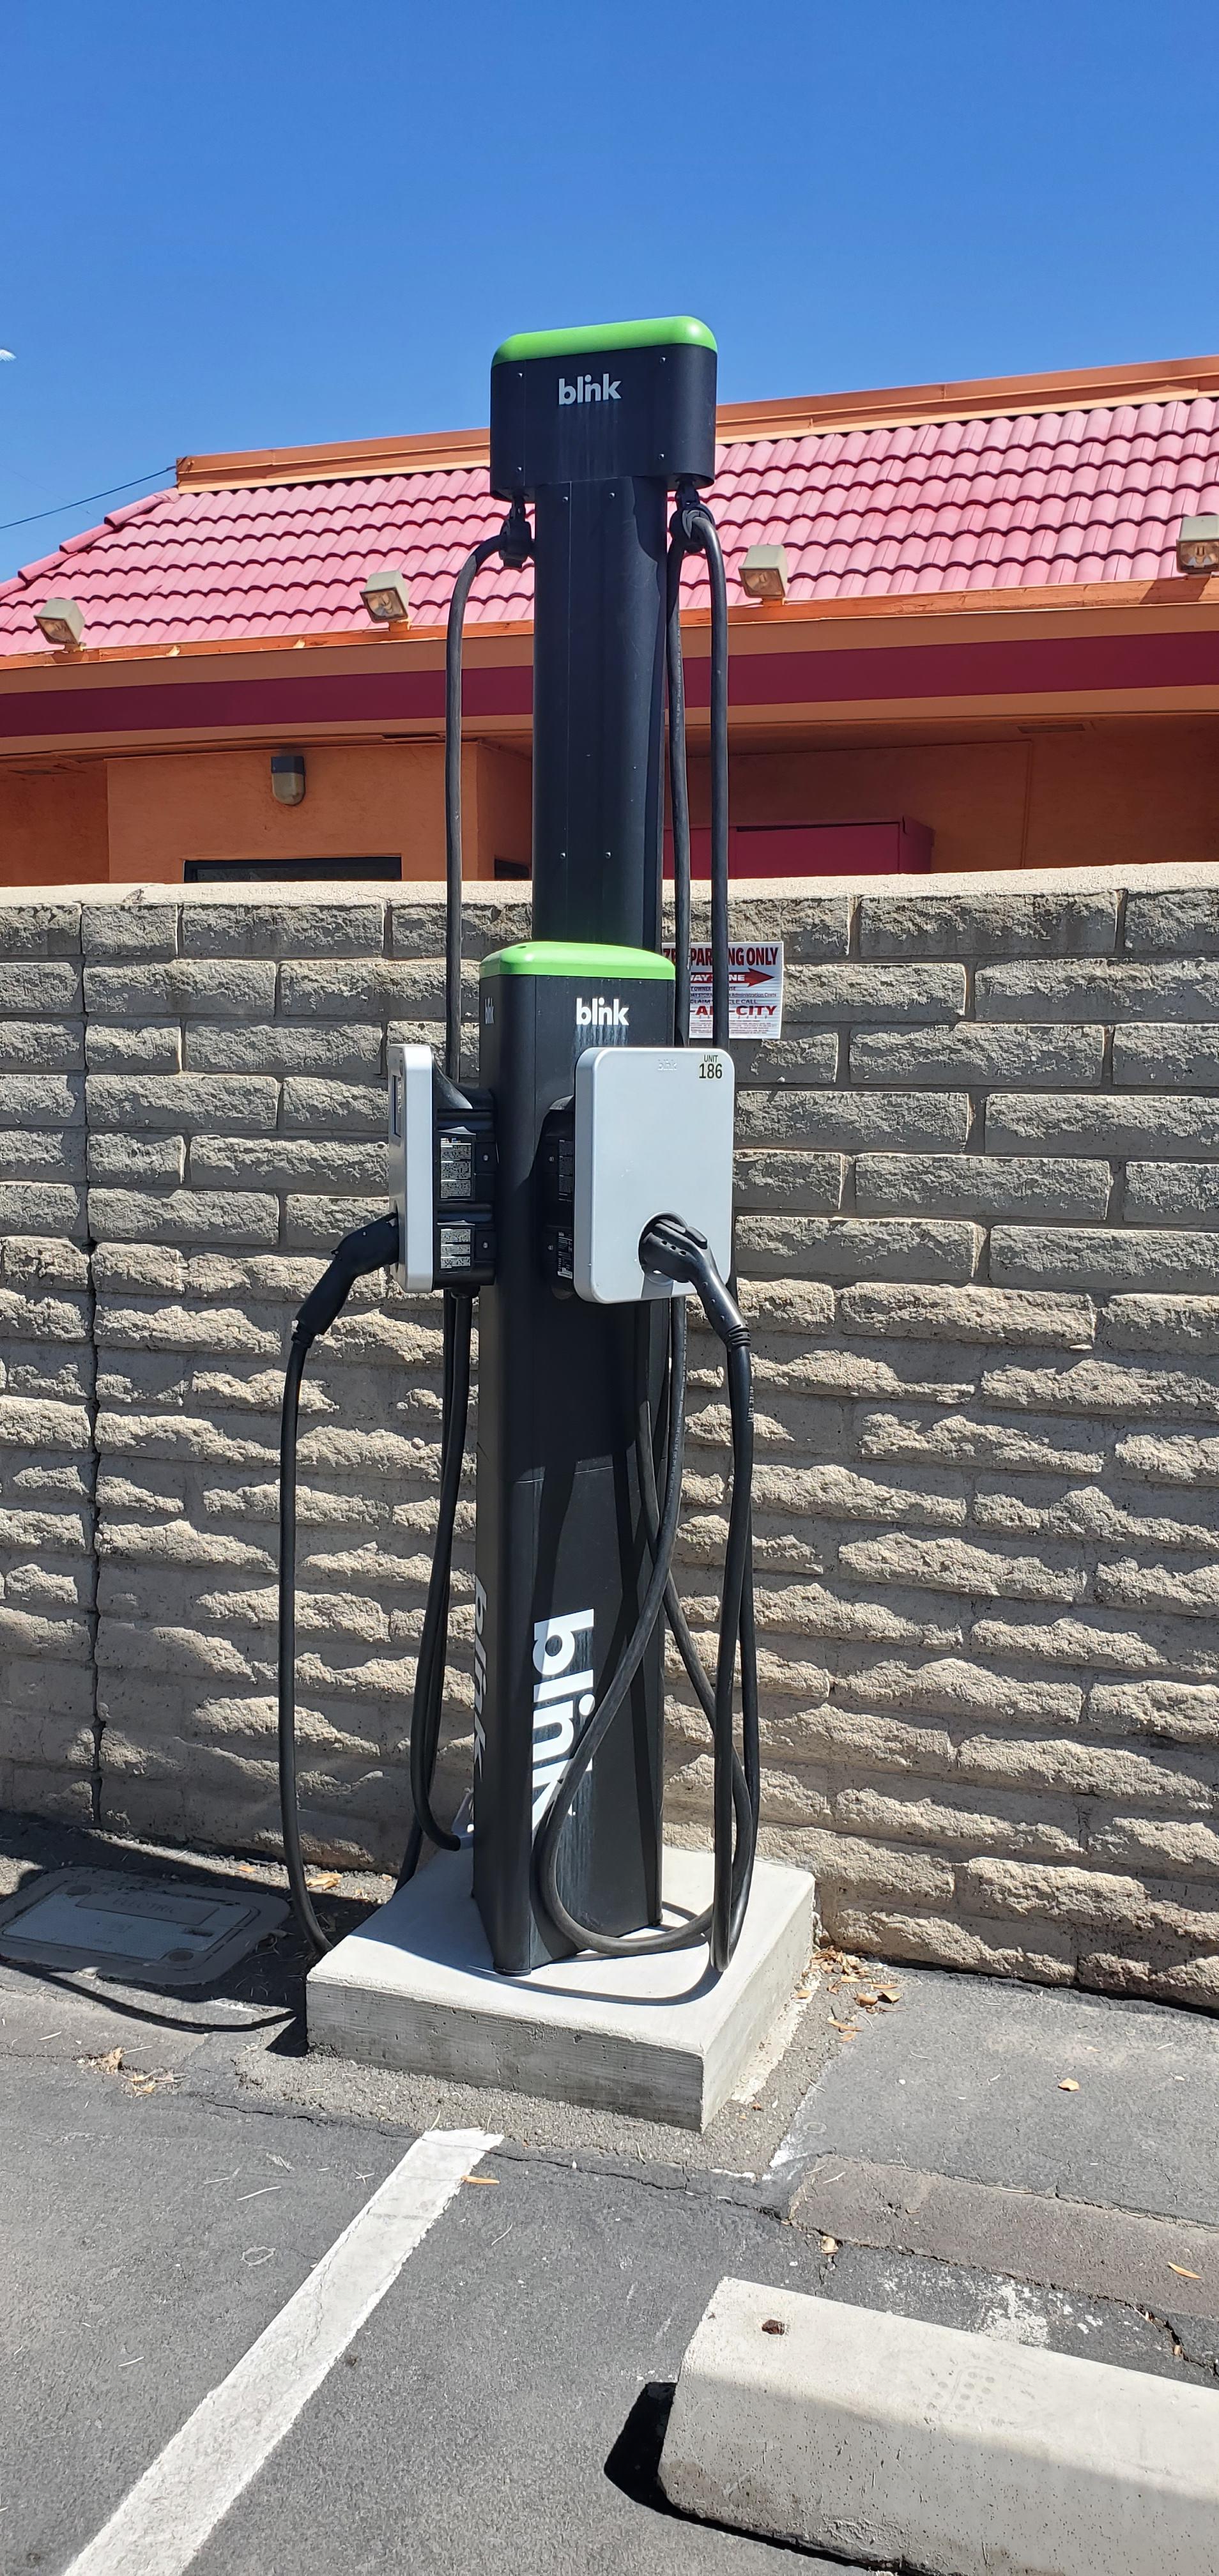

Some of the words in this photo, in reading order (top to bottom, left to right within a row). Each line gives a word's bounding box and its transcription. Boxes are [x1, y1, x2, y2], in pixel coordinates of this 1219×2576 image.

[558, 373, 622, 405] blink
[691, 947, 744, 966] PARNG
[746, 947, 779, 966] ONLY
[576, 997, 629, 1025] blink
[699, 1063, 723, 1079] 186
[475, 1574, 487, 1781] blink
